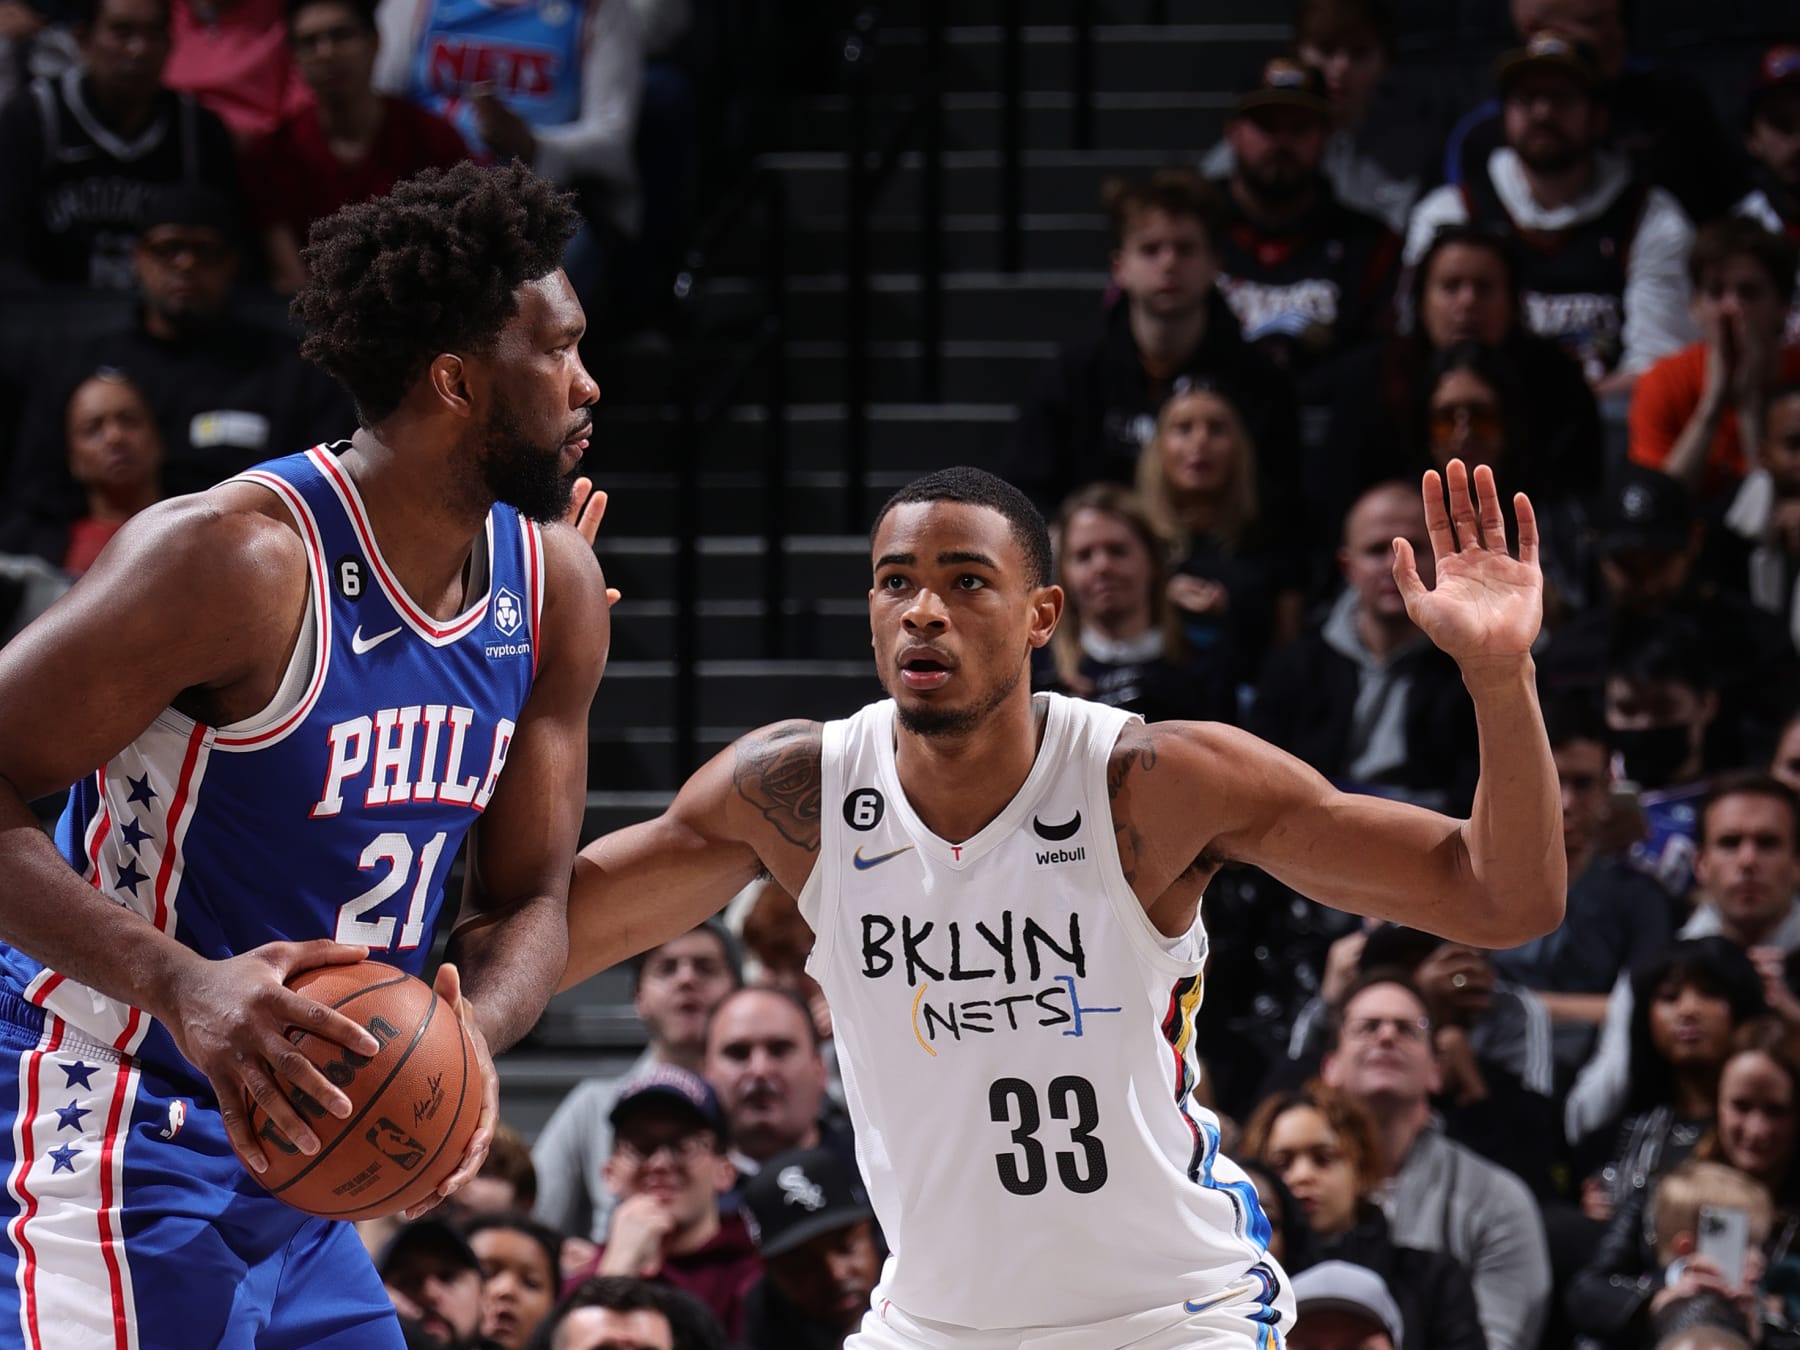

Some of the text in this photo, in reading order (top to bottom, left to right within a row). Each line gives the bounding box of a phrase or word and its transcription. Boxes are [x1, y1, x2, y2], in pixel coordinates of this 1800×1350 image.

[340, 561, 361, 596] 6
[853, 794, 877, 826] 6
[1036, 847, 1086, 865] Webull
[334, 831, 448, 952] 21
[861, 910, 1086, 986] BKLYN
[988, 1075, 1108, 1196] 33
